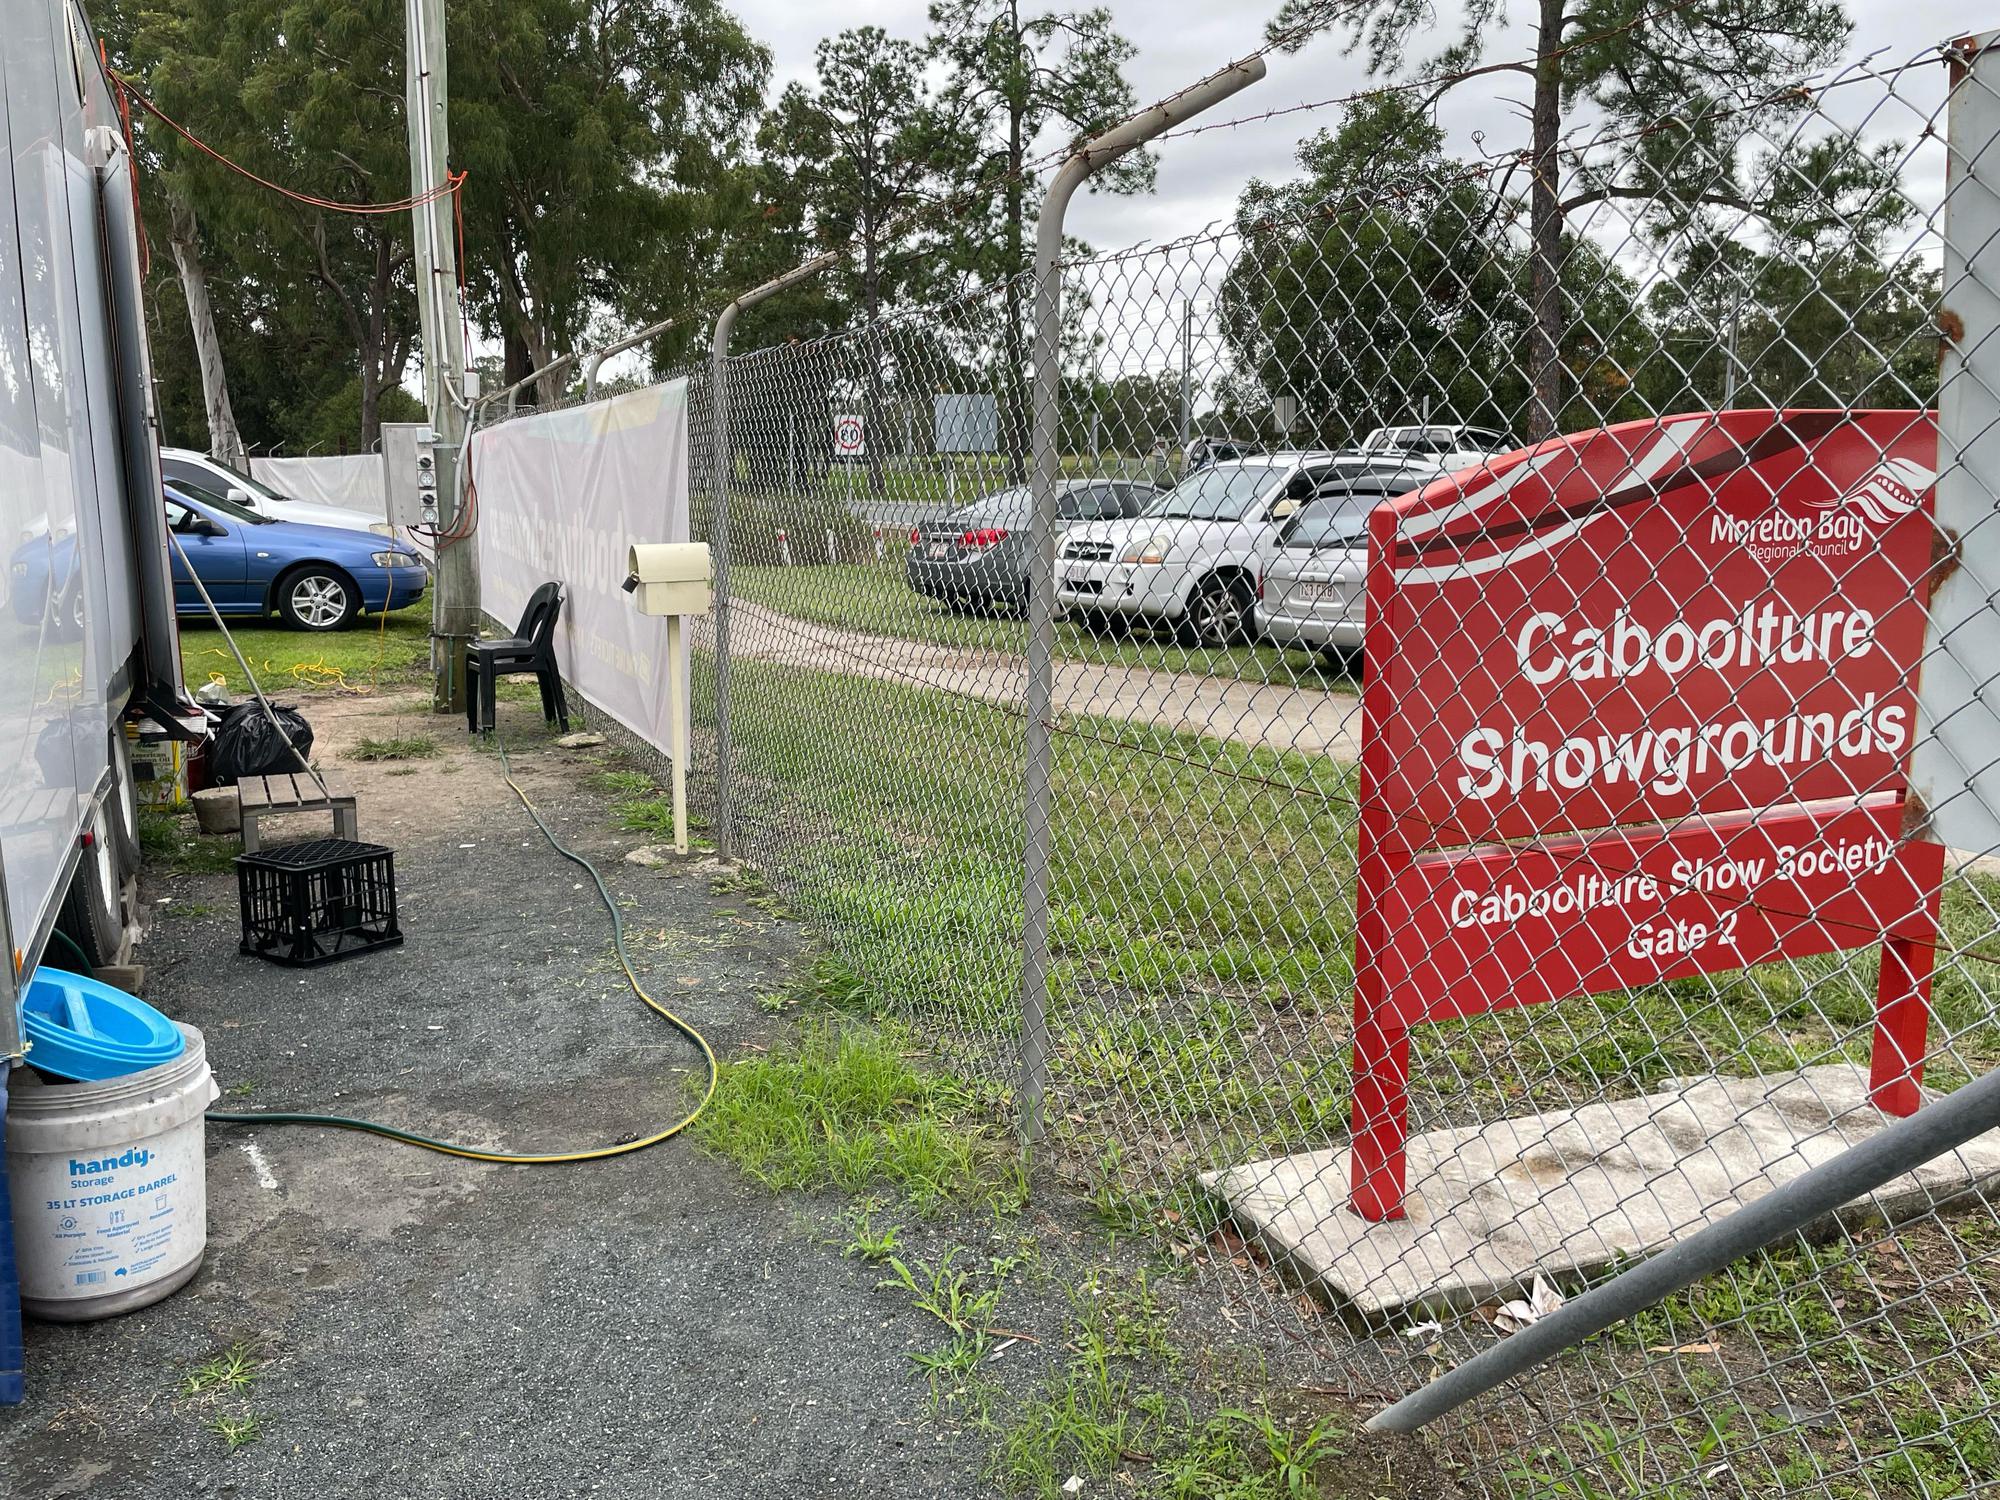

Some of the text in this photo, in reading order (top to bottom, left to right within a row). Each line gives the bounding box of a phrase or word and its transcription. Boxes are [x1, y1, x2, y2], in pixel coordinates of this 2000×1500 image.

[1710, 510, 1864, 551] Moreton Bay
[1749, 540, 1849, 563] Regional Council
[1517, 600, 1875, 685] Caboolture
[1458, 692, 1906, 801] Showgrounds
[1451, 835, 1896, 929] Caboolture Show Society
[1627, 909, 1738, 960] Gate 2
[46, 1174, 178, 1210] 35 LT STORAGE BARREL
[71, 1176, 115, 1189] Storage
